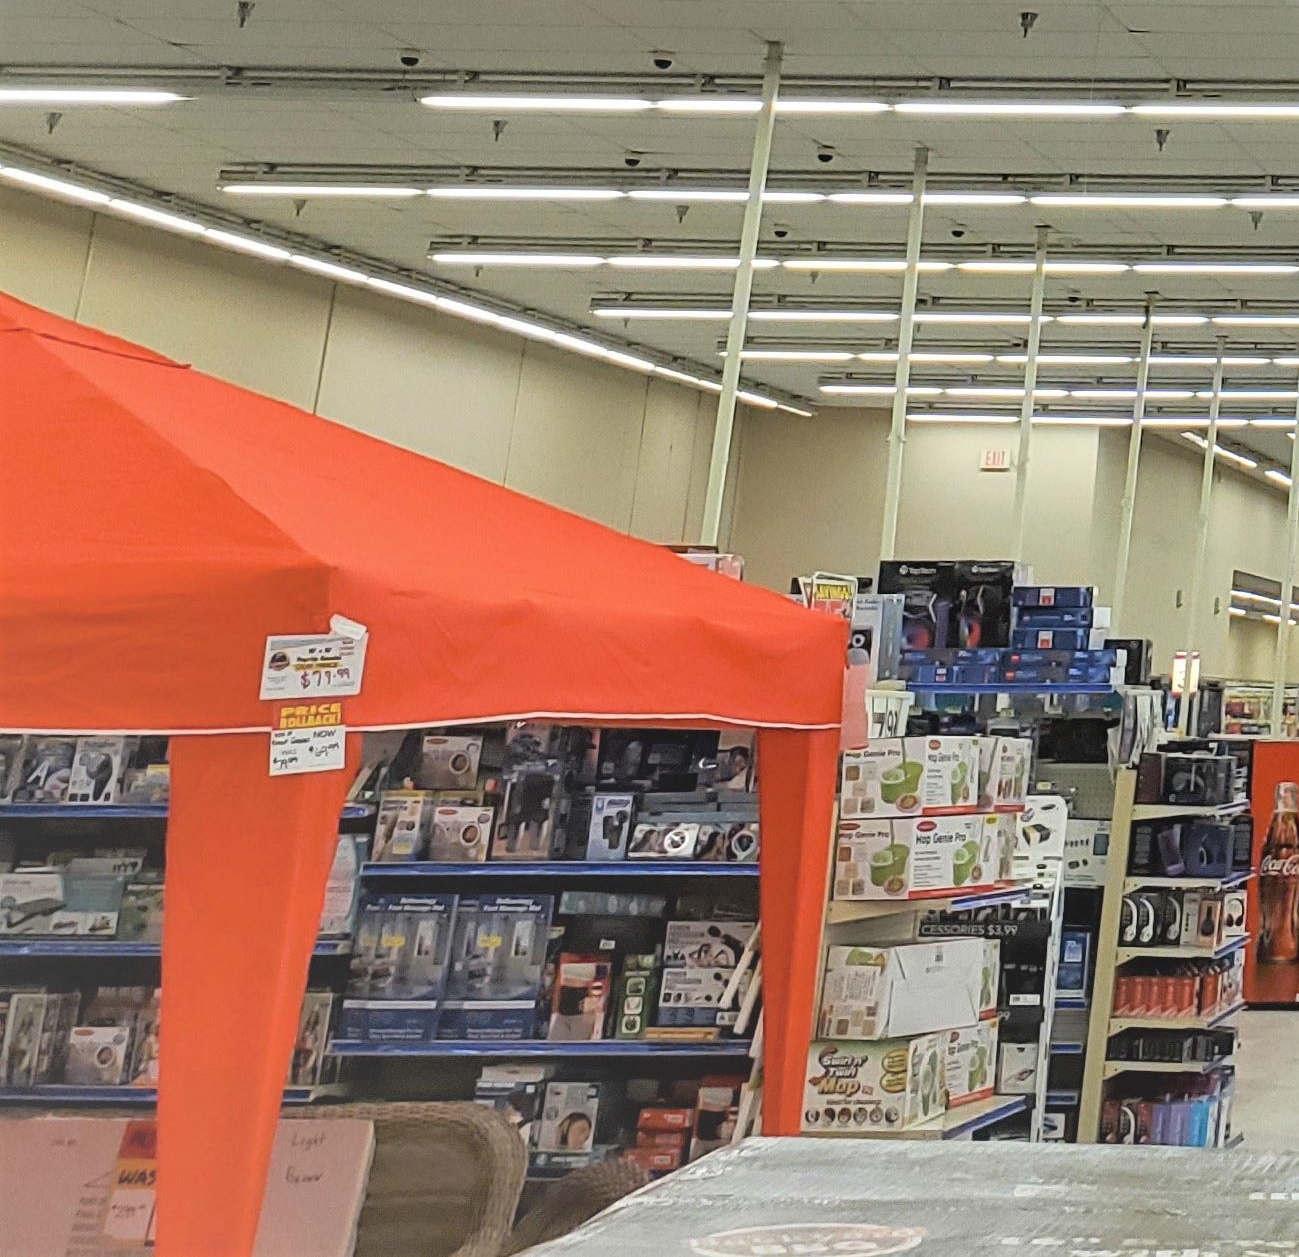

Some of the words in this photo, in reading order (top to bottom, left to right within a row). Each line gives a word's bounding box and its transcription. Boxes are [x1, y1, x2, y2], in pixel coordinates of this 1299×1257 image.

[280, 703, 341, 718] PRICE
[313, 729, 336, 739] NOW
[864, 750, 886, 758] Genie
[888, 749, 901, 757] Pro
[877, 831, 890, 839] Pro
[933, 833, 953, 843] Genie
[954, 832, 967, 843] Pro
[987, 924, 1018, 936] $3.99
[818, 1077, 861, 1098] Mop
